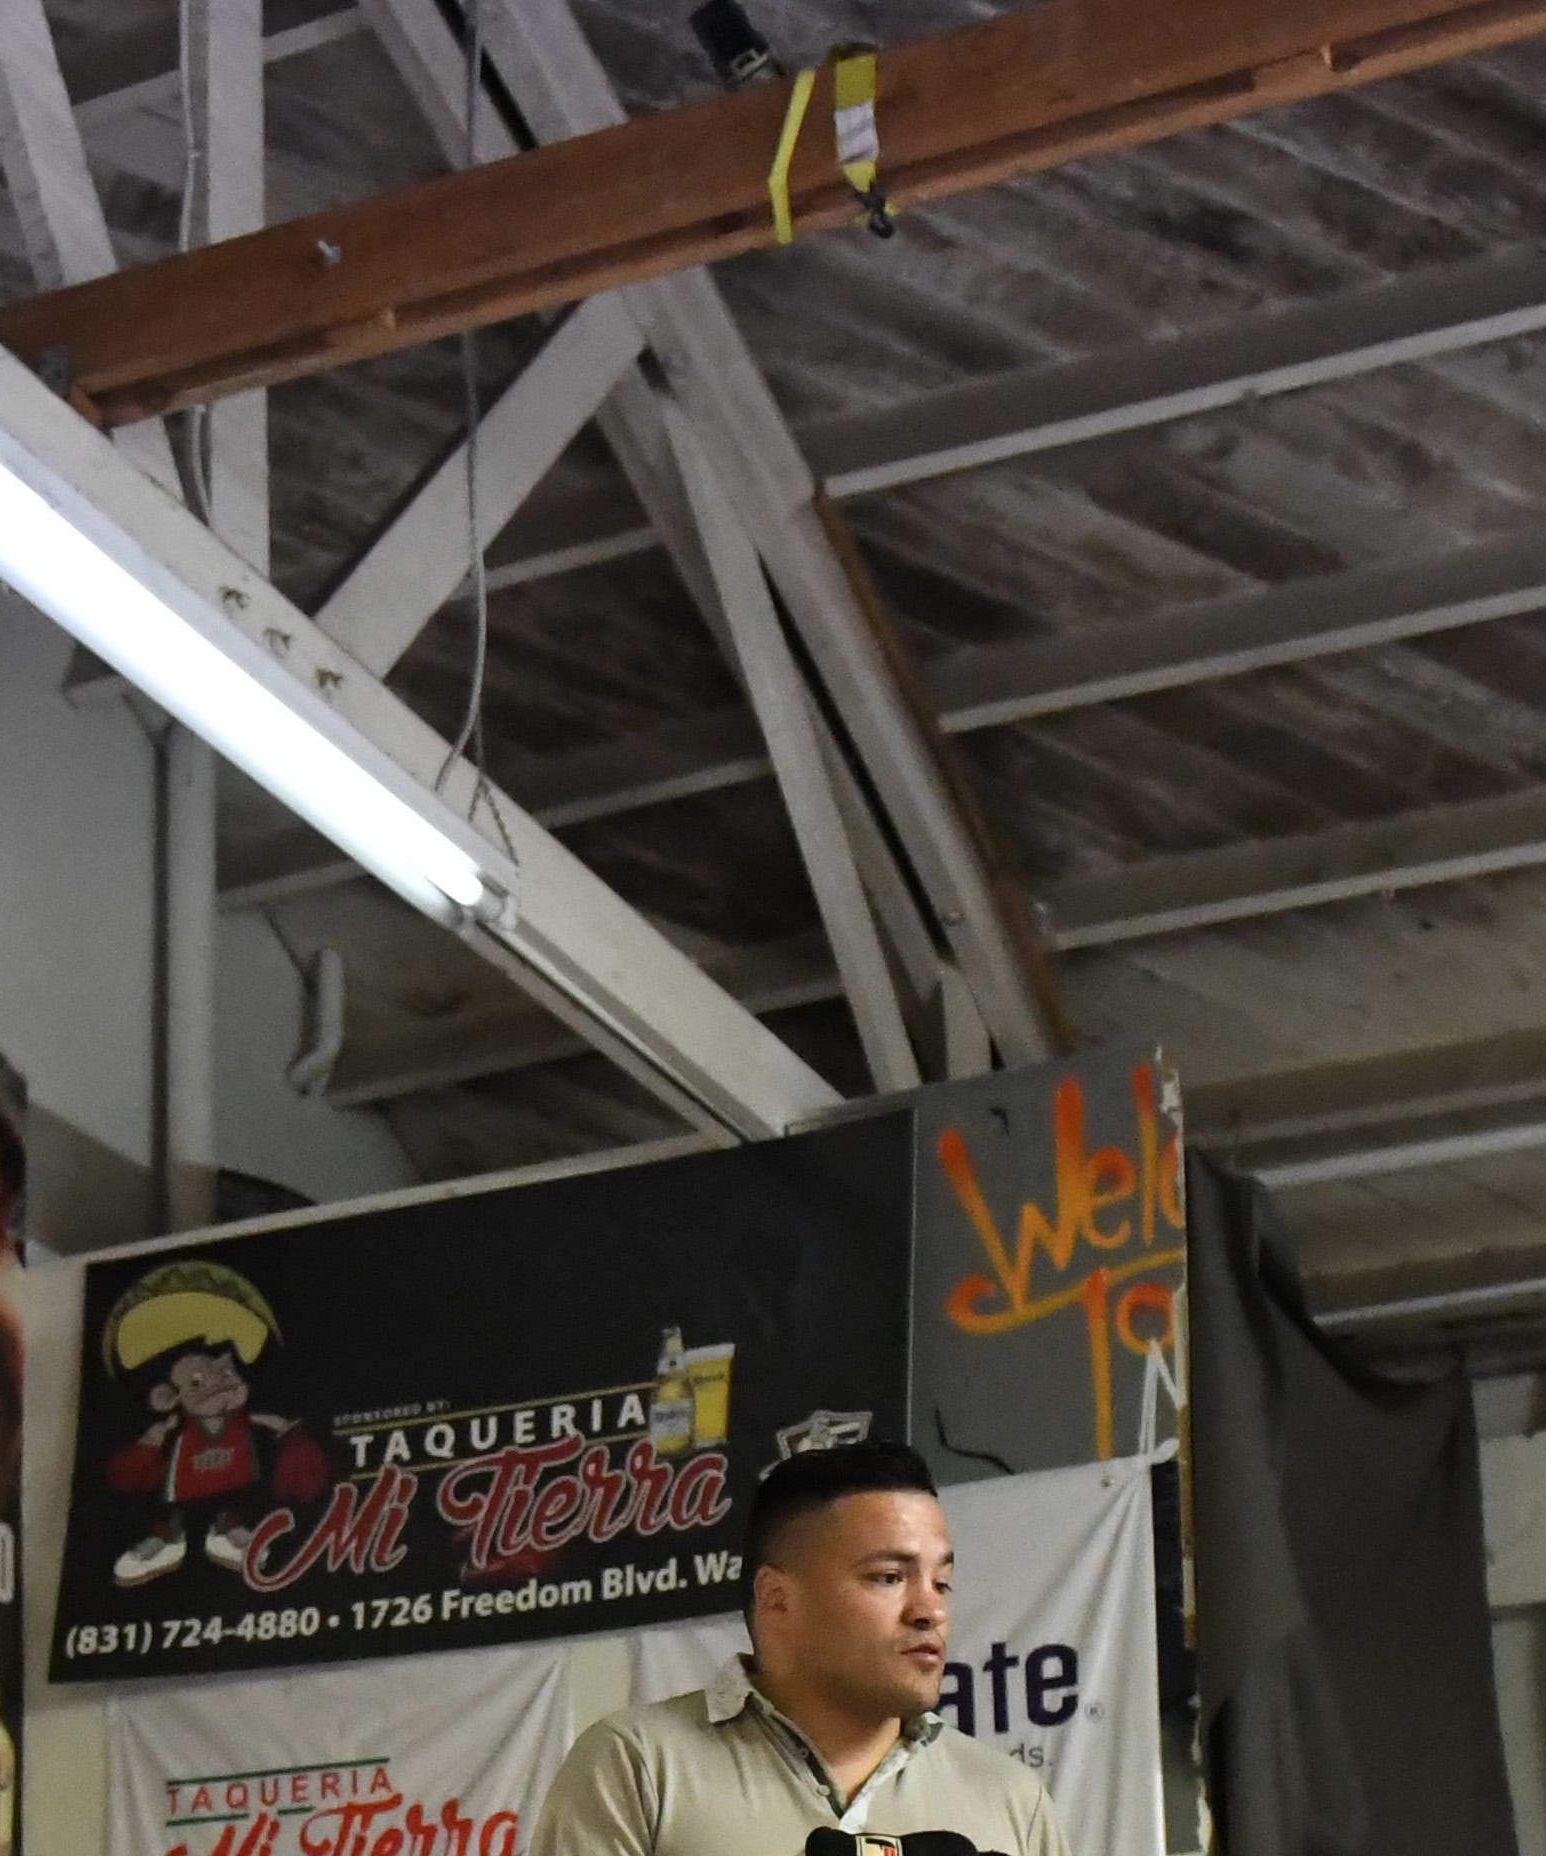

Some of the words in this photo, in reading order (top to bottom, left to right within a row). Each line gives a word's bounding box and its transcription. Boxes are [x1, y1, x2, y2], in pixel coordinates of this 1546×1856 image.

[350, 1393, 646, 1467] TAQUERIA
[243, 1463, 418, 1592] Mi
[438, 1430, 732, 1571] Tierra
[65, 1621, 153, 1658] (831)
[162, 1606, 320, 1649] 724-4880
[352, 1594, 432, 1630] 1726
[441, 1578, 593, 1621] Freedom
[603, 1557, 687, 1600] Blvd.
[167, 1767, 396, 1815] TAQUERIA
